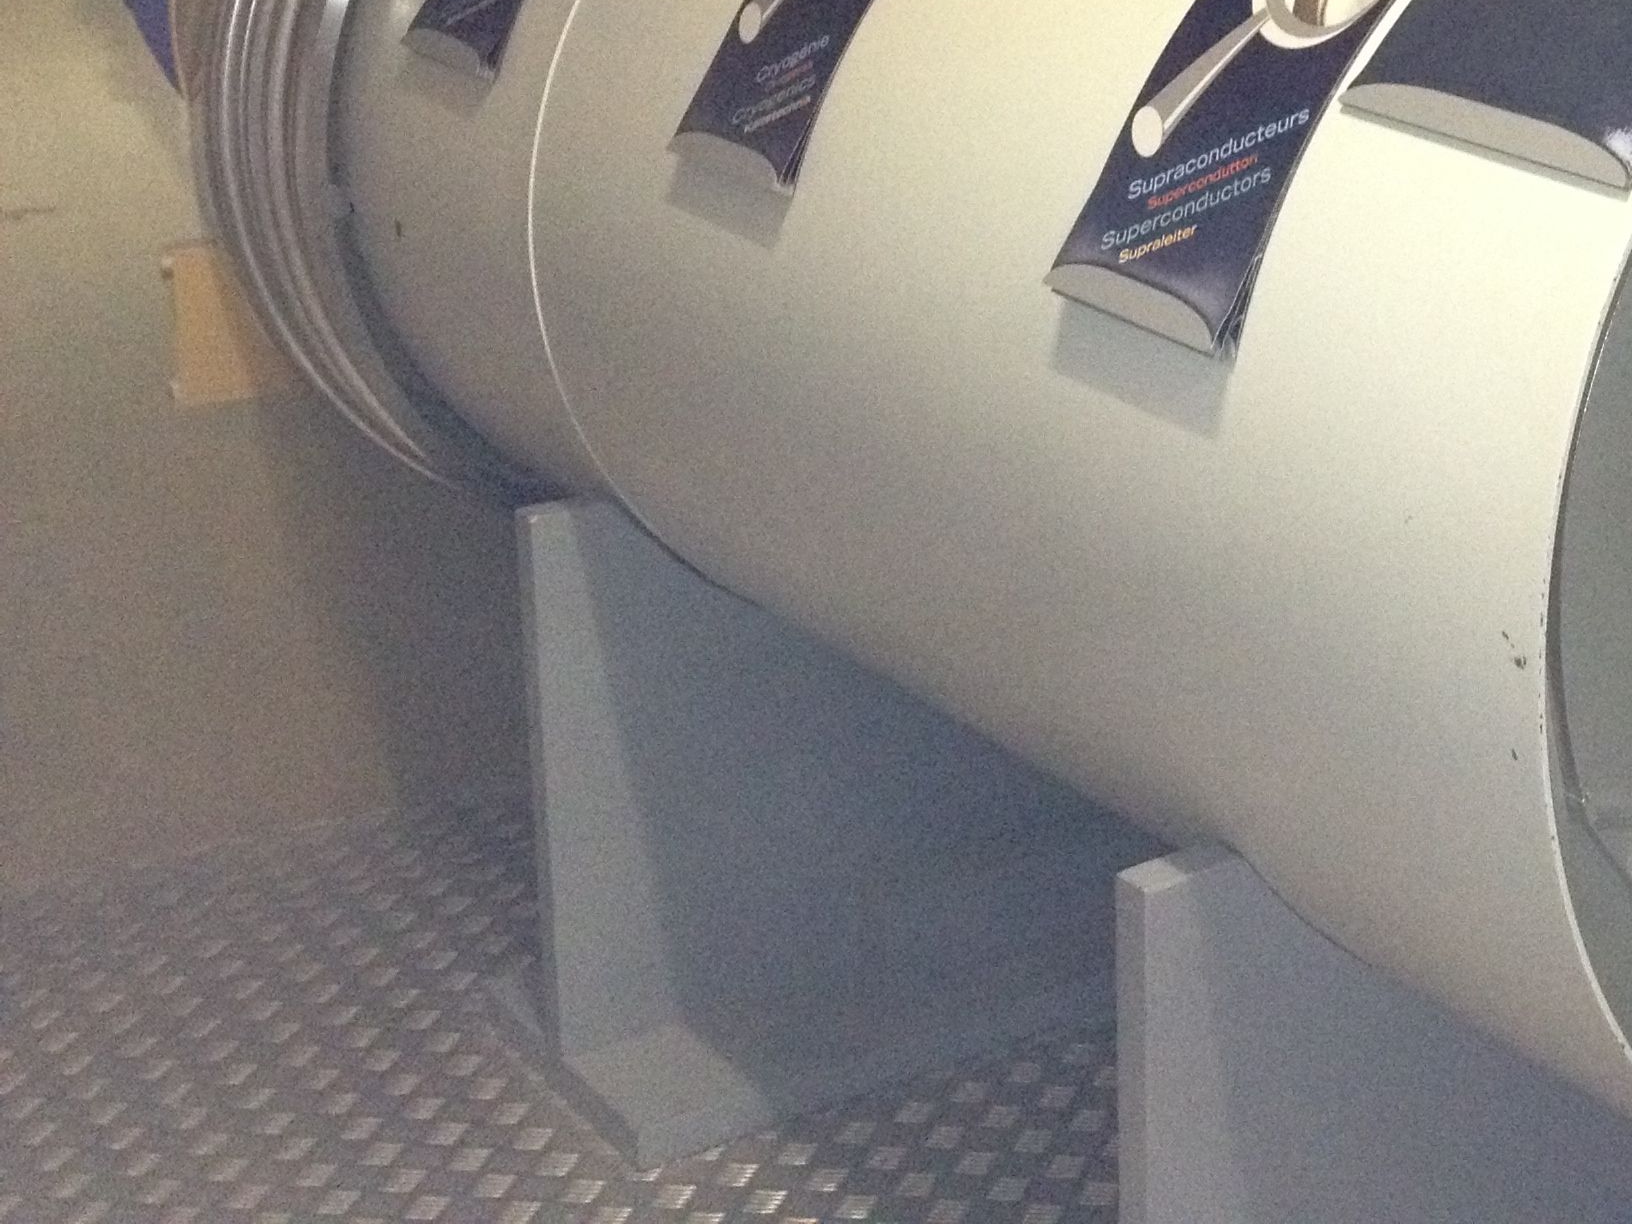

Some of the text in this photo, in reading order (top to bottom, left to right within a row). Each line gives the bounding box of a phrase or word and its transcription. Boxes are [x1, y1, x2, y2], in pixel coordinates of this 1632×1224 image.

[1127, 107, 1310, 199] Supraconducteurs
[1100, 166, 1272, 251] Superconductors
[1118, 223, 1198, 264] Supraleiter
